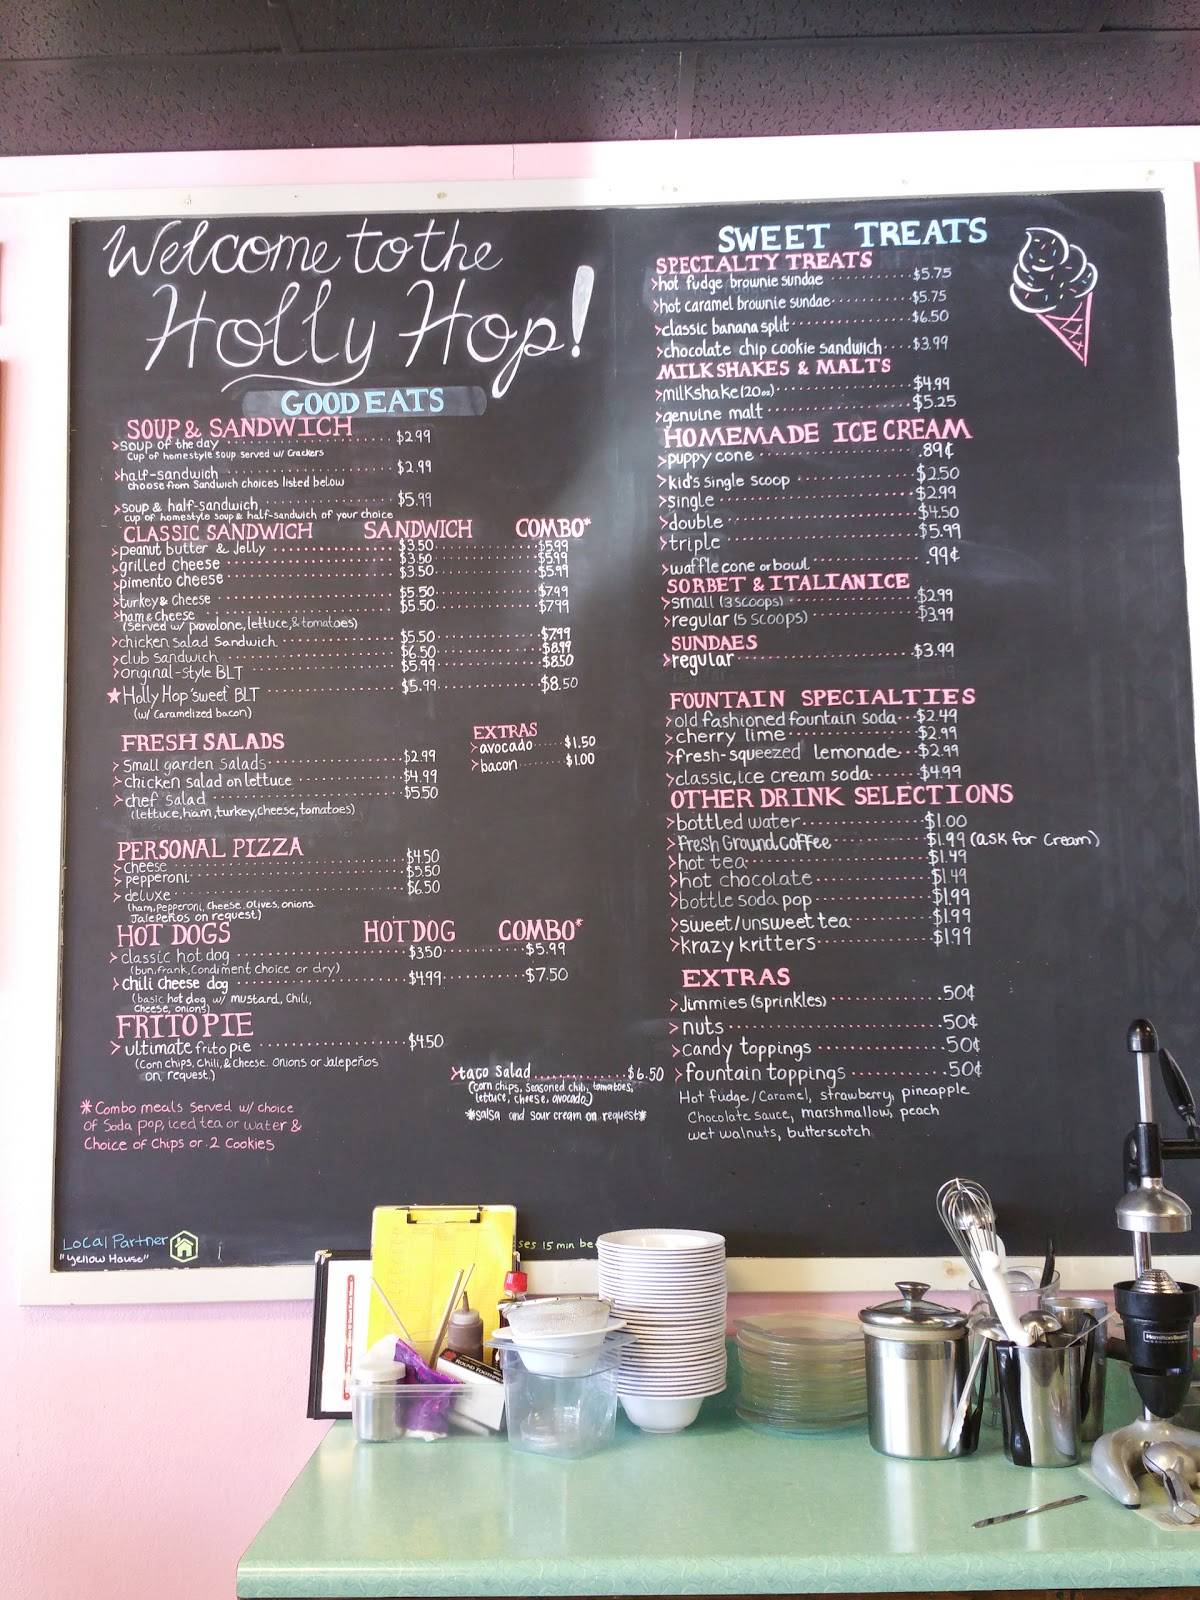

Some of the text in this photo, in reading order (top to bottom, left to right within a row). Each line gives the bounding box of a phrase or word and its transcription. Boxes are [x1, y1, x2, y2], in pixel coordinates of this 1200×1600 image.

[718, 217, 987, 254] SWEET TREATS
[103, 218, 503, 278] Welcome to the
[656, 251, 872, 275] SPECIALTY TREATS
[655, 267, 952, 295] hot fudge brownie sundae $5.75
[658, 290, 946, 314] hot caramel brownie sundae $5.75
[145, 264, 594, 400] Holly Hop!
[660, 309, 949, 337] classic banana split $6.50
[662, 335, 948, 360] chocolate chip cookie sandwich $3.99
[816, 358, 891, 374] MALTS
[281, 388, 444, 418] GOOD EATS
[661, 403, 763, 429] genuine malt
[127, 415, 352, 441] SOUP & SANDWICH
[664, 418, 973, 448] HOMEMADE ICE CREAM
[120, 430, 430, 454] soup of the day $2.99
[163, 449, 214, 461] homestyle
[666, 451, 754, 469] puppy cone
[119, 459, 431, 481] half-sandwich $2.99
[669, 463, 960, 491] kid's single scoop $2.50
[242, 475, 344, 488] choices listed below
[168, 491, 431, 512] half-sandwich $5.99
[666, 485, 956, 512] single $2.99
[246, 508, 393, 519] half-sandwich choice
[667, 503, 959, 530] double $4.50
[124, 521, 312, 544] CLASSIC SANDWICH
[364, 518, 472, 541] SANDWICH
[669, 522, 961, 556] triple $5.99
[120, 541, 208, 559] peanut butter
[118, 555, 220, 577] grilled cheese
[670, 557, 810, 575] waffle cone bowl
[118, 572, 223, 591] pimento cheese
[119, 634, 169, 648] chicken
[672, 635, 758, 651] SUNDAES
[118, 650, 219, 665] club sandwich
[671, 643, 954, 676] regular $3.99
[121, 658, 435, 685] original-style BLT $5.99
[123, 685, 188, 708] Holly Hop
[670, 688, 976, 711] FOUNTAIN SPECIALTIES
[216, 706, 252, 719] bacon)
[675, 709, 897, 730] old fashioned fountain soda
[473, 722, 537, 740] EXTRAS
[676, 726, 786, 747] cherry lime
[121, 733, 284, 752] FRESH SALADS
[479, 735, 596, 754] avocado $1.50
[164, 749, 435, 775] garden $2.99
[481, 753, 595, 773] bacon $1.00
[771, 765, 871, 783] cream soda
[671, 783, 1014, 809] OTHER DRINK SELECTIONS
[677, 813, 800, 831] bottled water
[970, 831, 1035, 847] (ask for
[117, 837, 304, 864] PERSONAL PIZZA
[124, 870, 191, 890] pepperoni
[720, 870, 812, 890] chocolate
[125, 889, 171, 901] deluxe
[679, 891, 812, 914] bottle pop
[117, 920, 231, 947] HOT DOGS
[364, 920, 455, 943] HOT DOG
[121, 942, 565, 964] classic $5.99
[679, 935, 816, 962] krazy kritters
[122, 967, 568, 991] chili $7.50
[681, 968, 790, 987] EXTRAS
[751, 991, 826, 1013] (sprinkles)
[116, 1012, 253, 1041] FRITO PIE
[683, 1019, 724, 1037] nuts
[125, 1040, 251, 1059] ultimate pie
[682, 1036, 811, 1065] candy toppings
[901, 1082, 970, 1103] pineapple
[141, 1100, 183, 1114] meals
[801, 1104, 939, 1122] marshmallow, peach
[244, 1120, 287, 1131] water
[720, 1124, 872, 1141] walnuts, butterscotch
[112, 1234, 168, 1248] Partner
[543, 1241, 553, 1250] 15
[455, 1359, 475, 1371] ROUND
